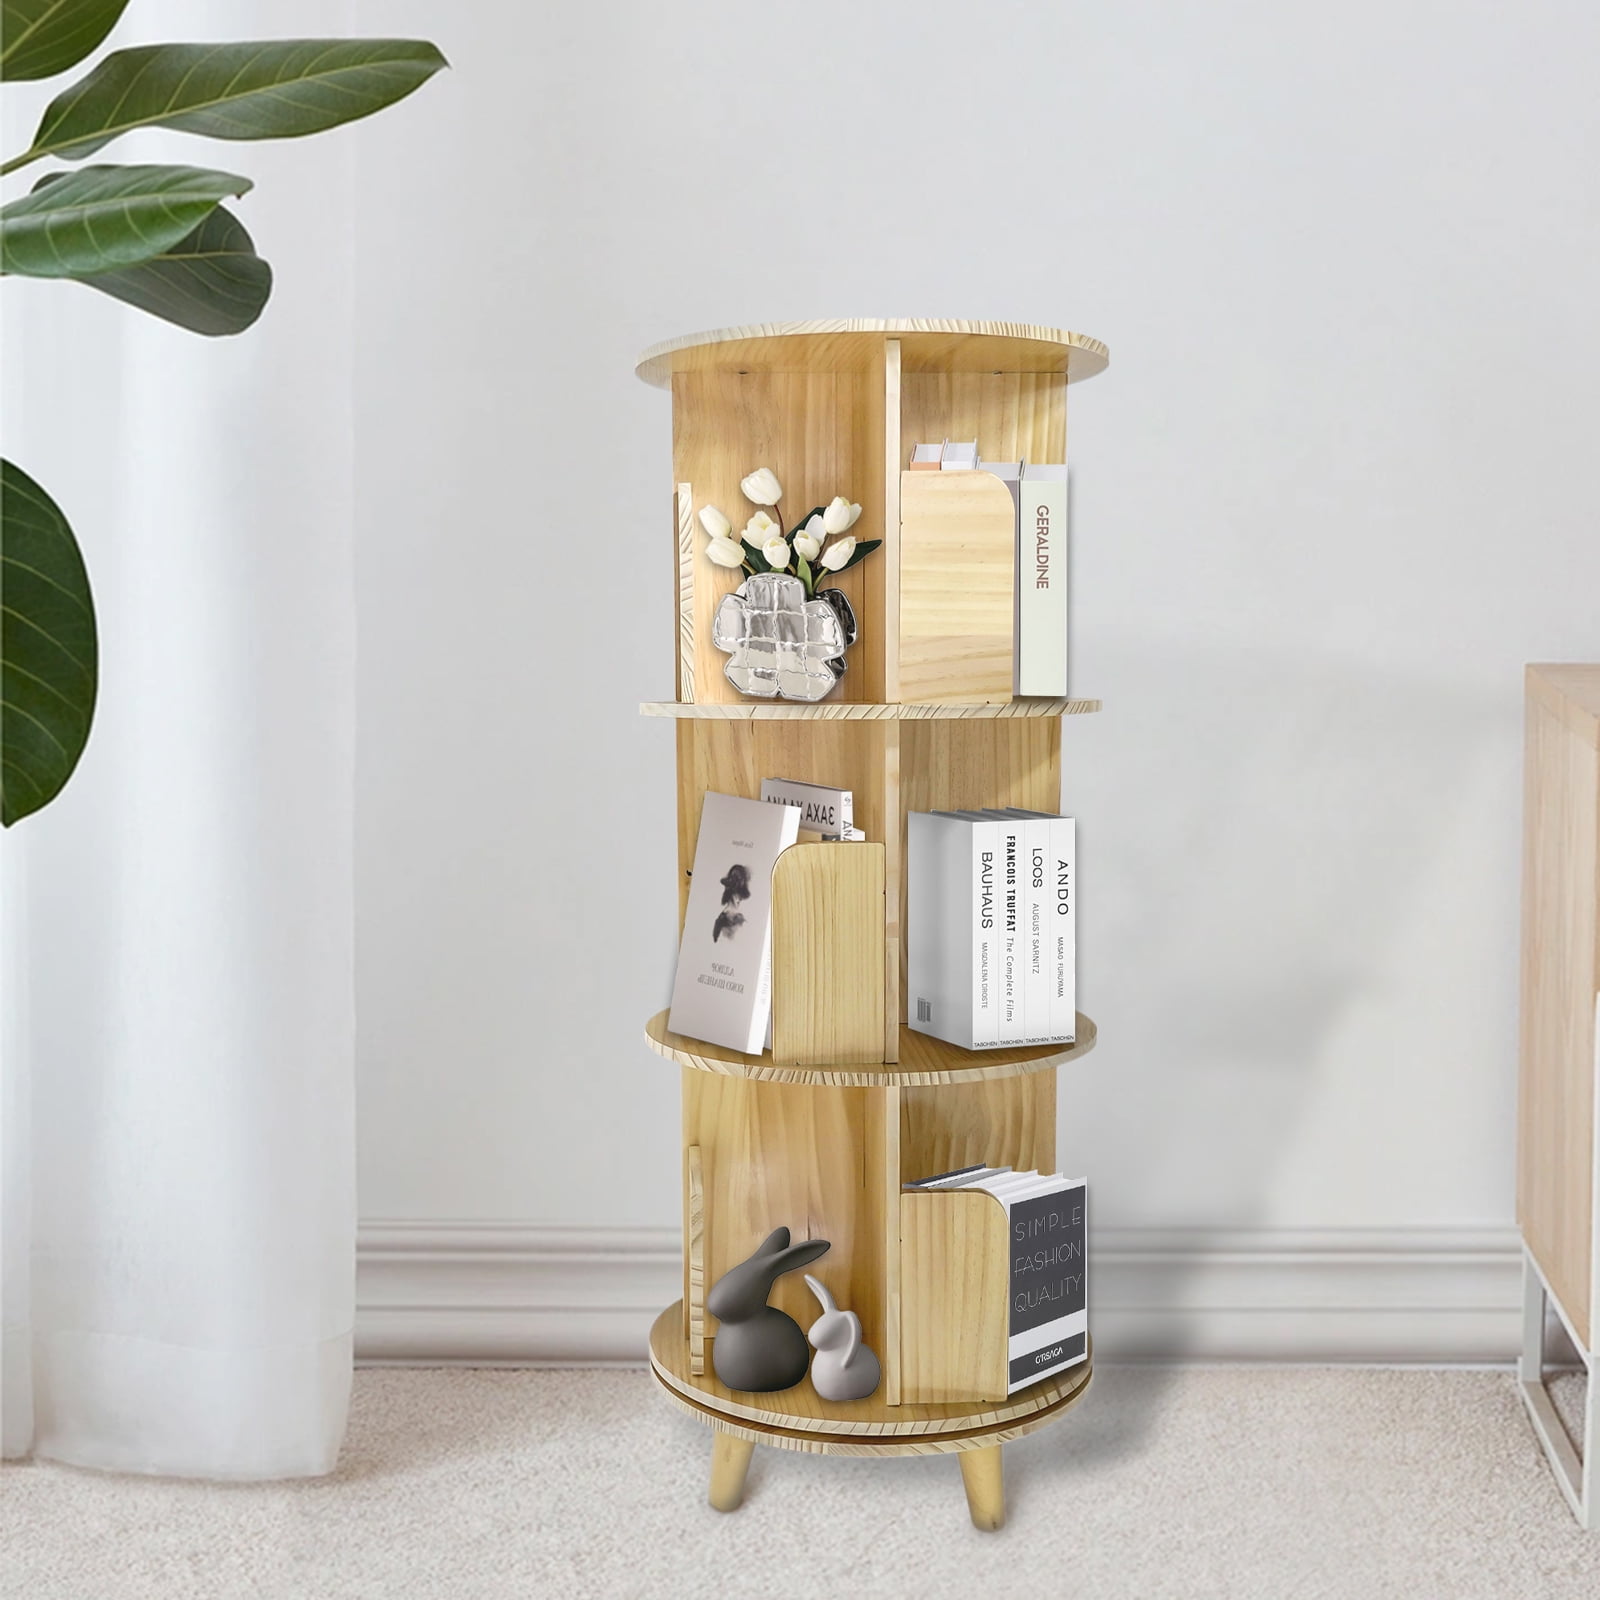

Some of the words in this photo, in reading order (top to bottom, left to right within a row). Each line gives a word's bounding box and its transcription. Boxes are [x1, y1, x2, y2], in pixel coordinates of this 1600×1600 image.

[1036, 504, 1049, 590] GERALDINE
[1006, 835, 1016, 885] FRANCOIS
[1032, 848, 1043, 888] LOOS
[981, 852, 993, 929] BAUHAUS
[1057, 860, 1069, 916] ANDO
[1006, 889, 1016, 932] TRUFFAT
[1032, 903, 1040, 936] AUGUST
[1006, 937, 1014, 953] The
[1032, 939, 1040, 975] SARNITZ
[1005, 955, 1014, 997] Complete
[1006, 999, 1014, 1023] Films
[1000, 1038, 1024, 1046] TASCHEN
[1051, 1034, 1075, 1042] TASCHEN
[1015, 1206, 1081, 1241] SIMPLE
[1014, 1239, 1081, 1278] FASHION
[1014, 1272, 1082, 1313] QUALITY
